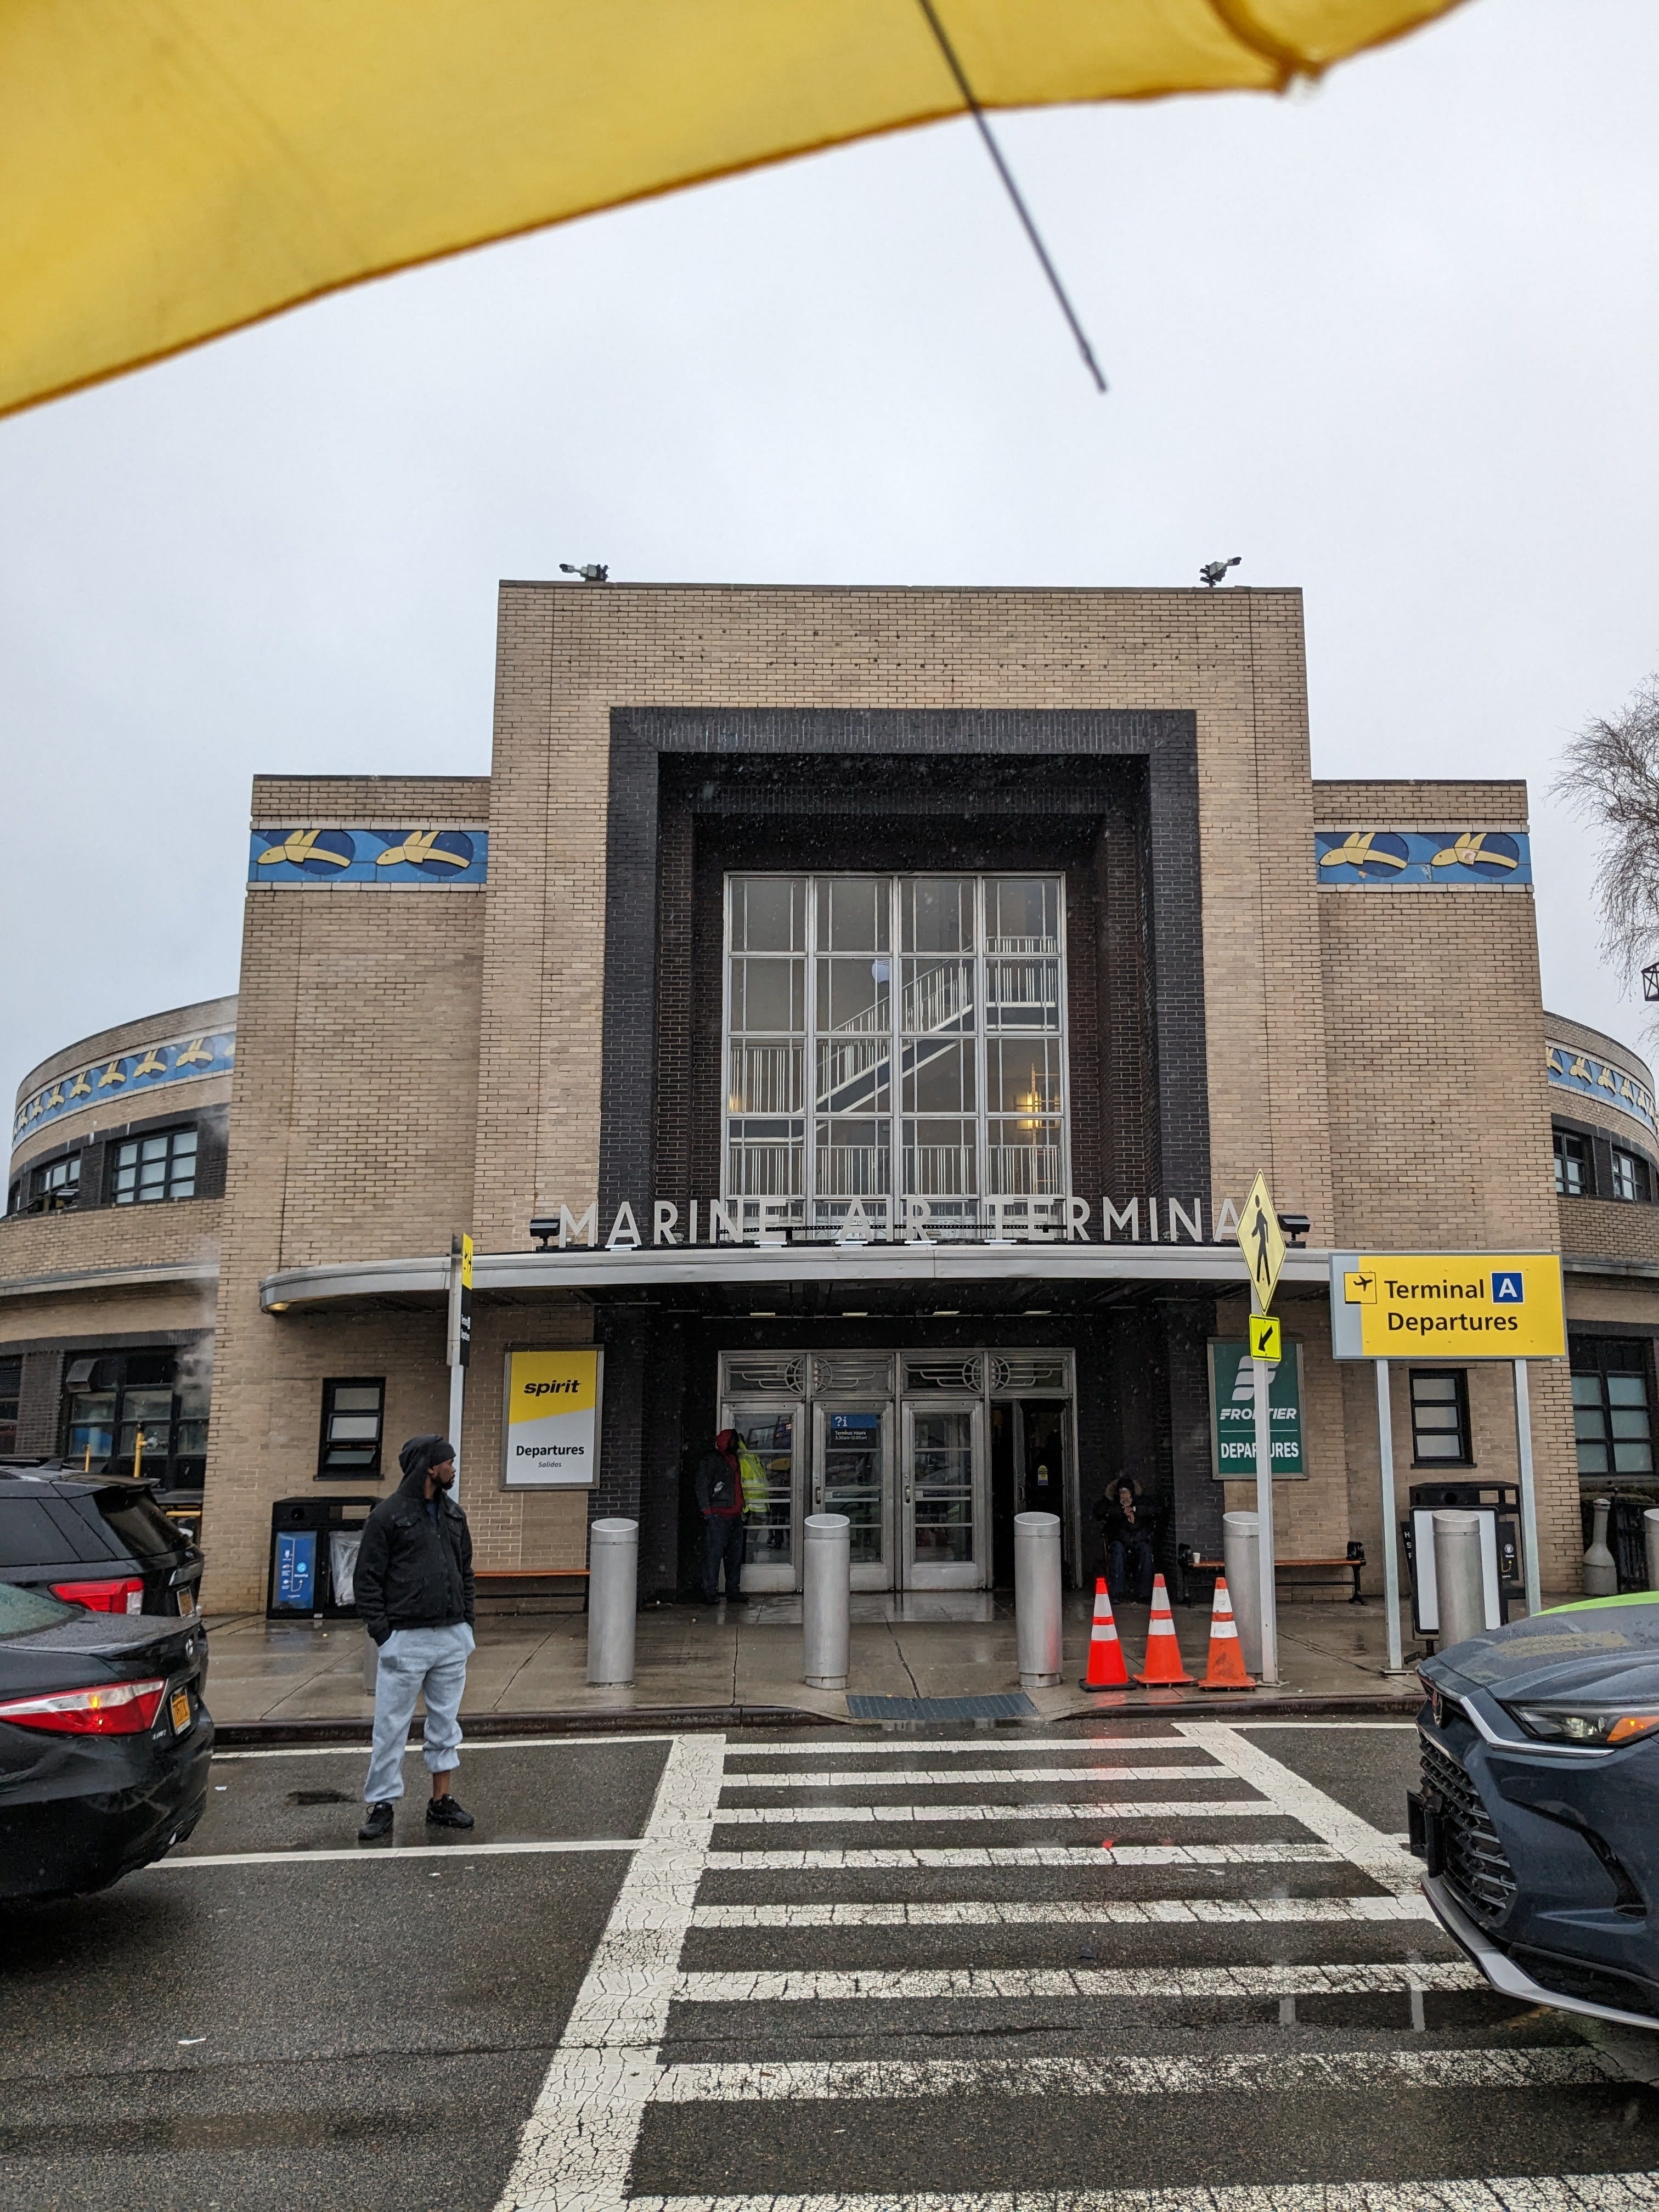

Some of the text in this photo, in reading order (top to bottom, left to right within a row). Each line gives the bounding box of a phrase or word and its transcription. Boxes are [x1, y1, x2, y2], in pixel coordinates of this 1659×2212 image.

[558, 1196, 1240, 1248] MARINE AIR TERMINA
[1384, 1278, 1518, 1299] Terminal A
[1387, 1312, 1519, 1336] Departures
[523, 1379, 580, 1397] spirit
[1219, 1408, 1297, 1420] FROIER
[516, 1445, 585, 1458] Departures
[1220, 1442, 1299, 1459] DEPARURES
